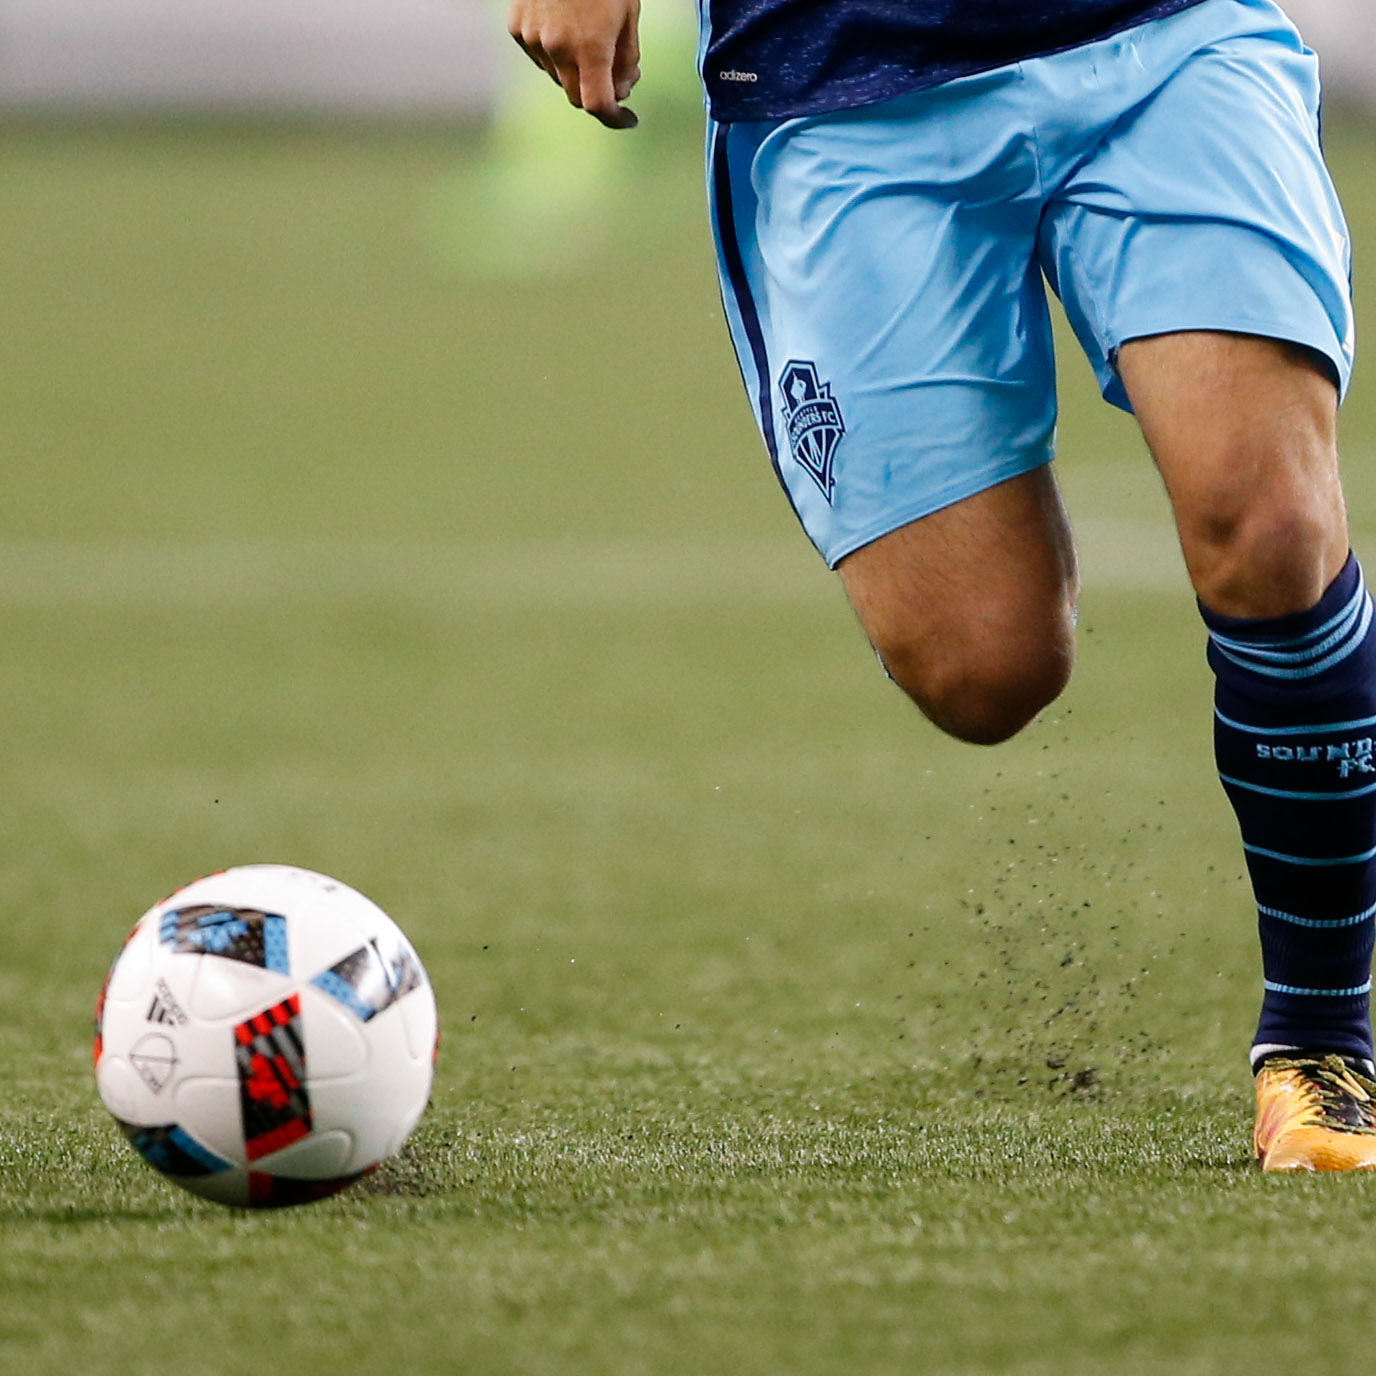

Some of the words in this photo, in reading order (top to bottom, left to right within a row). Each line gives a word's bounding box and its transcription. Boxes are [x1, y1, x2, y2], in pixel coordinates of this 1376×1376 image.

[720, 69, 758, 82] adizero
[821, 410, 836, 423] FC
[1337, 753, 1376, 778] FC
